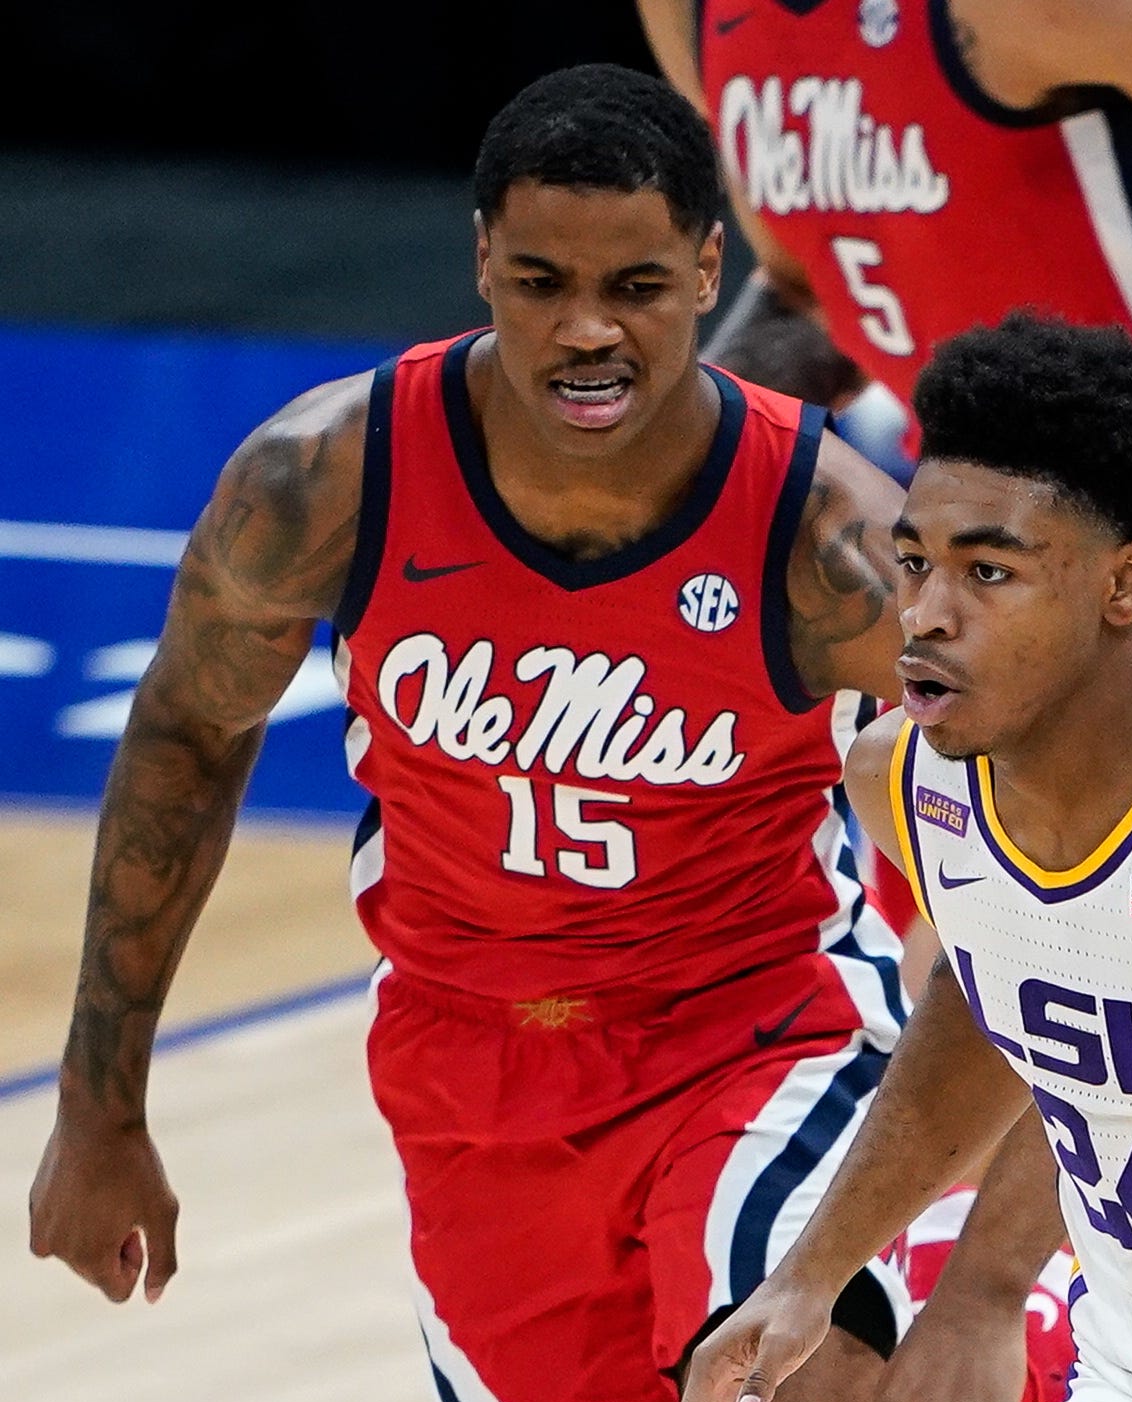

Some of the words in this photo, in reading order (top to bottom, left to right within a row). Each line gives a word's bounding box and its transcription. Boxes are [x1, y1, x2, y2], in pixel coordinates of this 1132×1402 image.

[719, 77, 810, 213] Ole
[790, 77, 949, 213] Miss
[831, 236, 915, 356] 5
[679, 573, 739, 632] SEC
[378, 633, 514, 768] Ole
[515, 646, 744, 786] Miss
[497, 775, 638, 890] 15
[918, 800, 964, 831] UNITED
